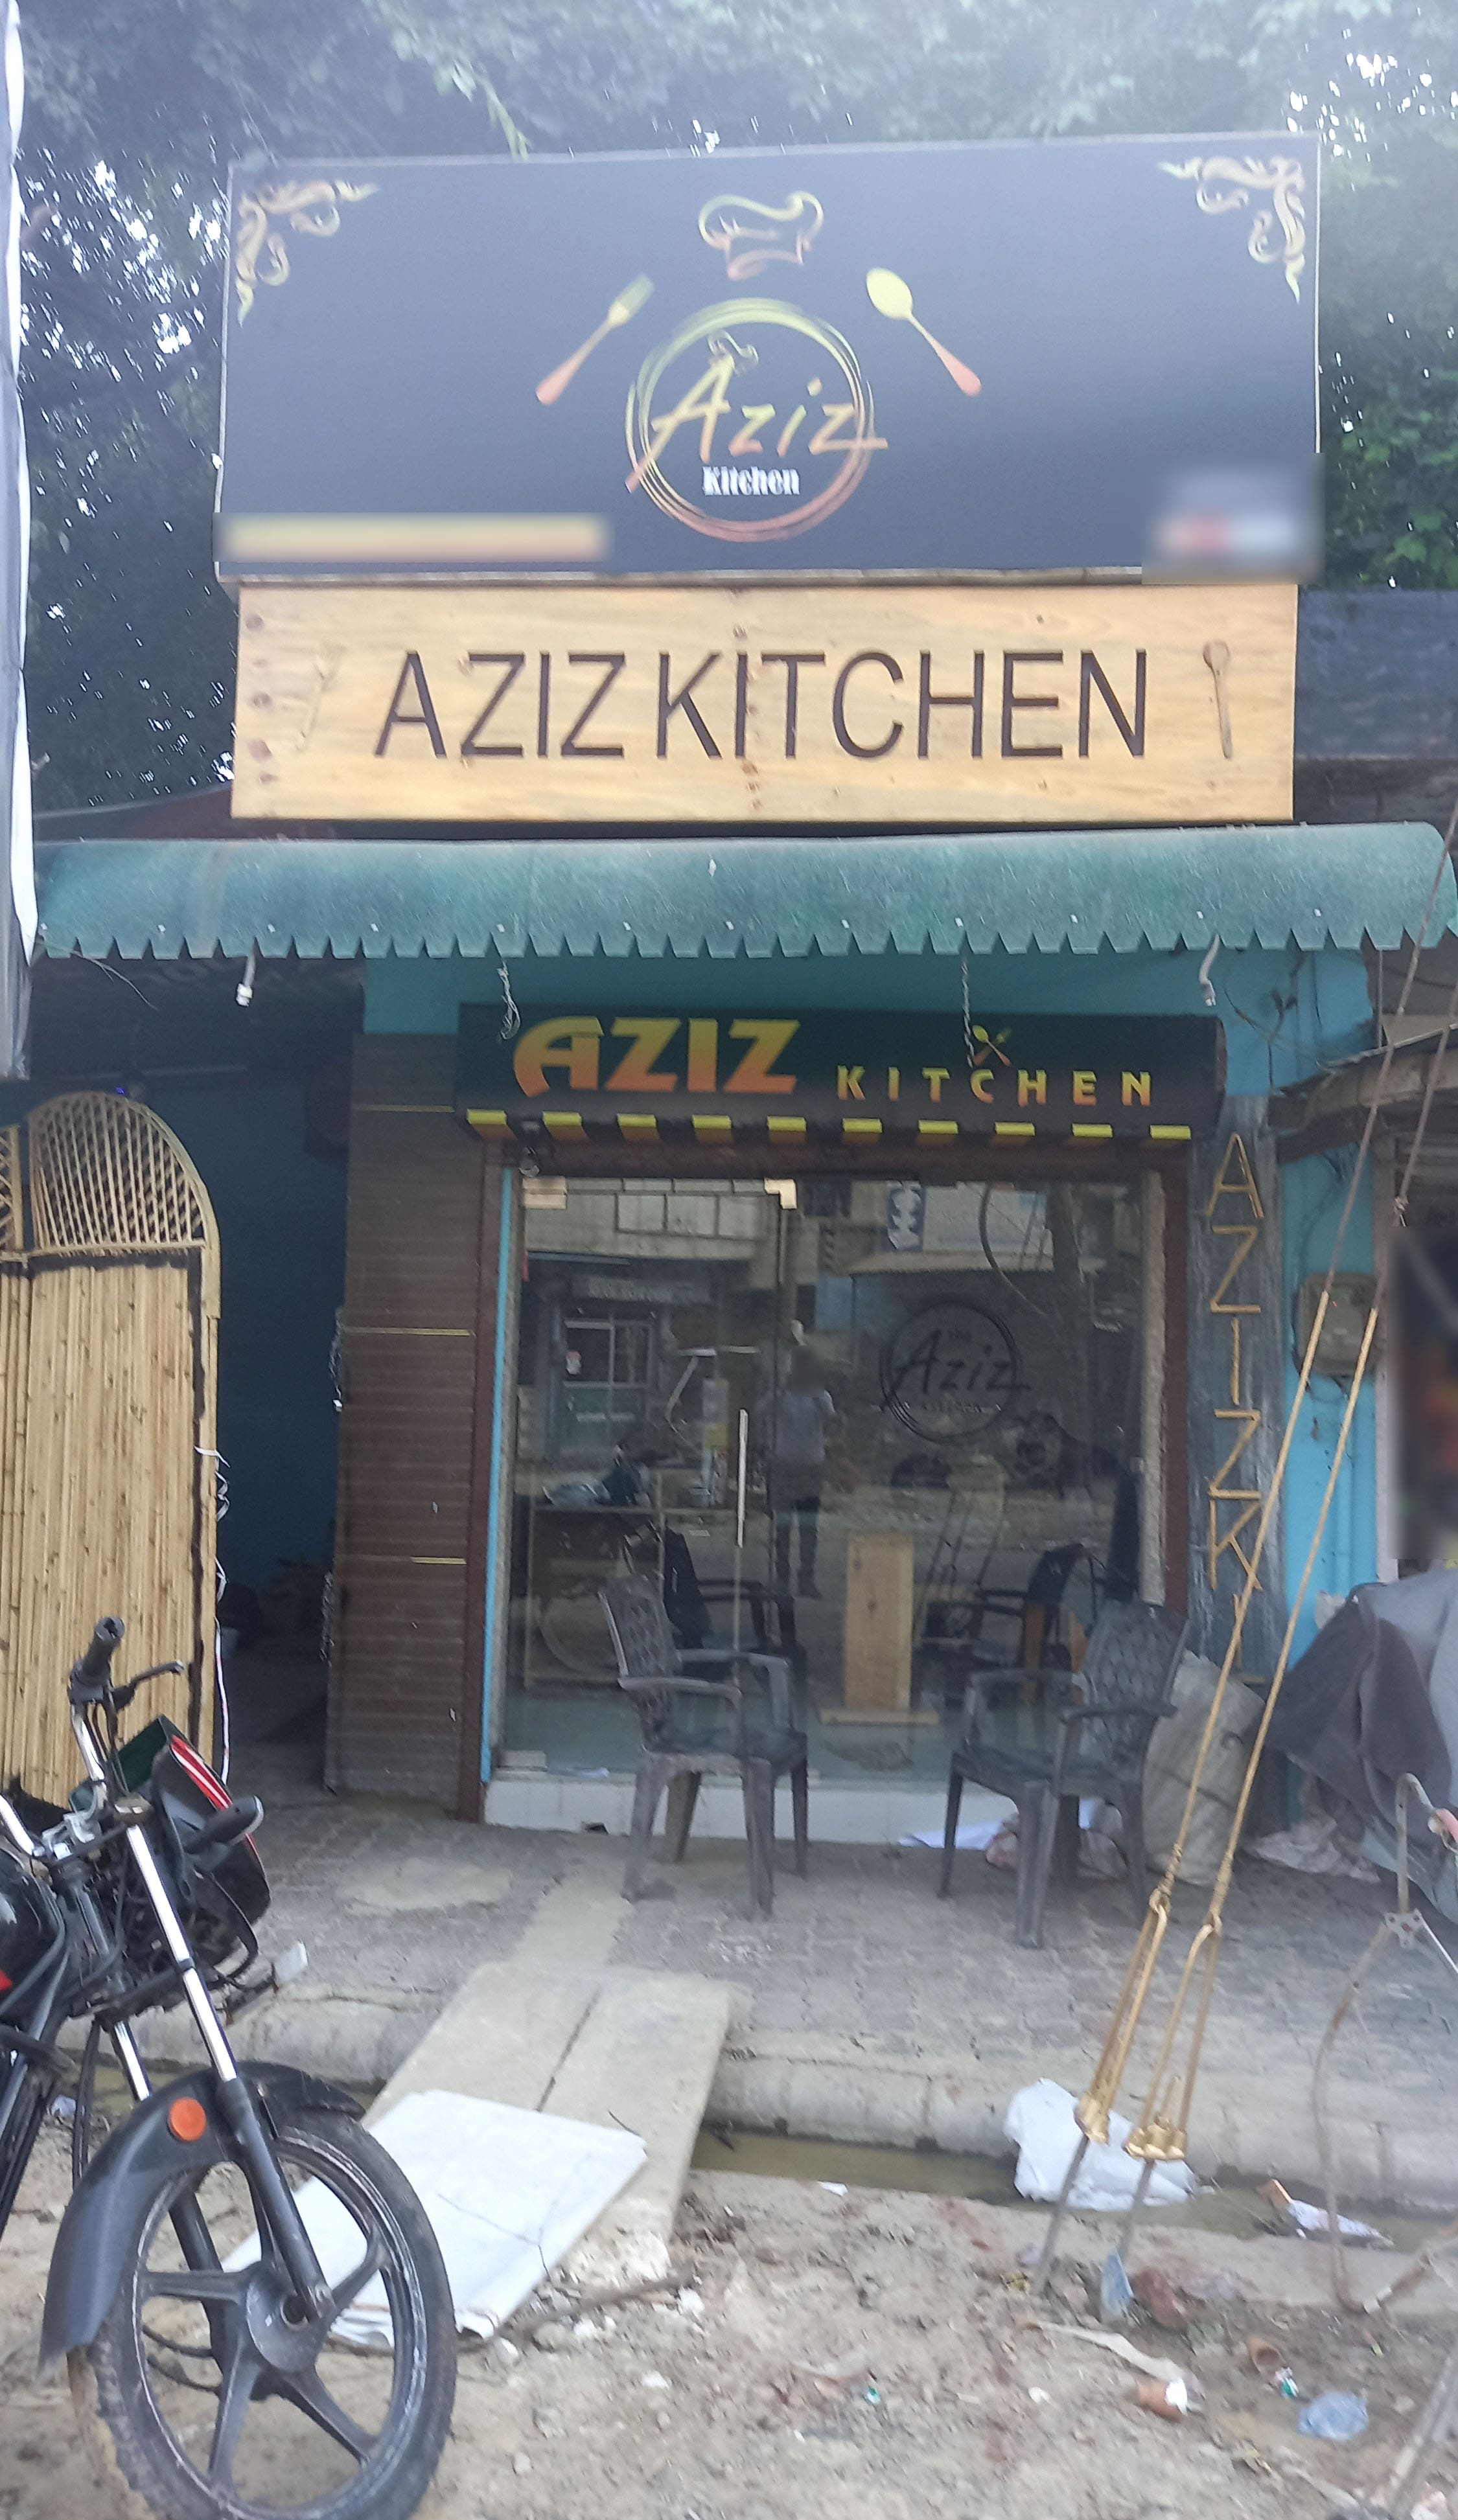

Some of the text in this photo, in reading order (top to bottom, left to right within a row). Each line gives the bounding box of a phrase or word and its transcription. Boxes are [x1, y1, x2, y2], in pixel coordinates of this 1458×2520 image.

[625, 353, 888, 494] Aziz
[702, 466, 800, 496] Kitchen
[373, 649, 1148, 759] AZIZ KITCHEN
[513, 1016, 1152, 1107] AZIZ KITCHEN
[1204, 1133, 1264, 1498] AZIZ
[881, 1328, 1032, 1411] Aziz
